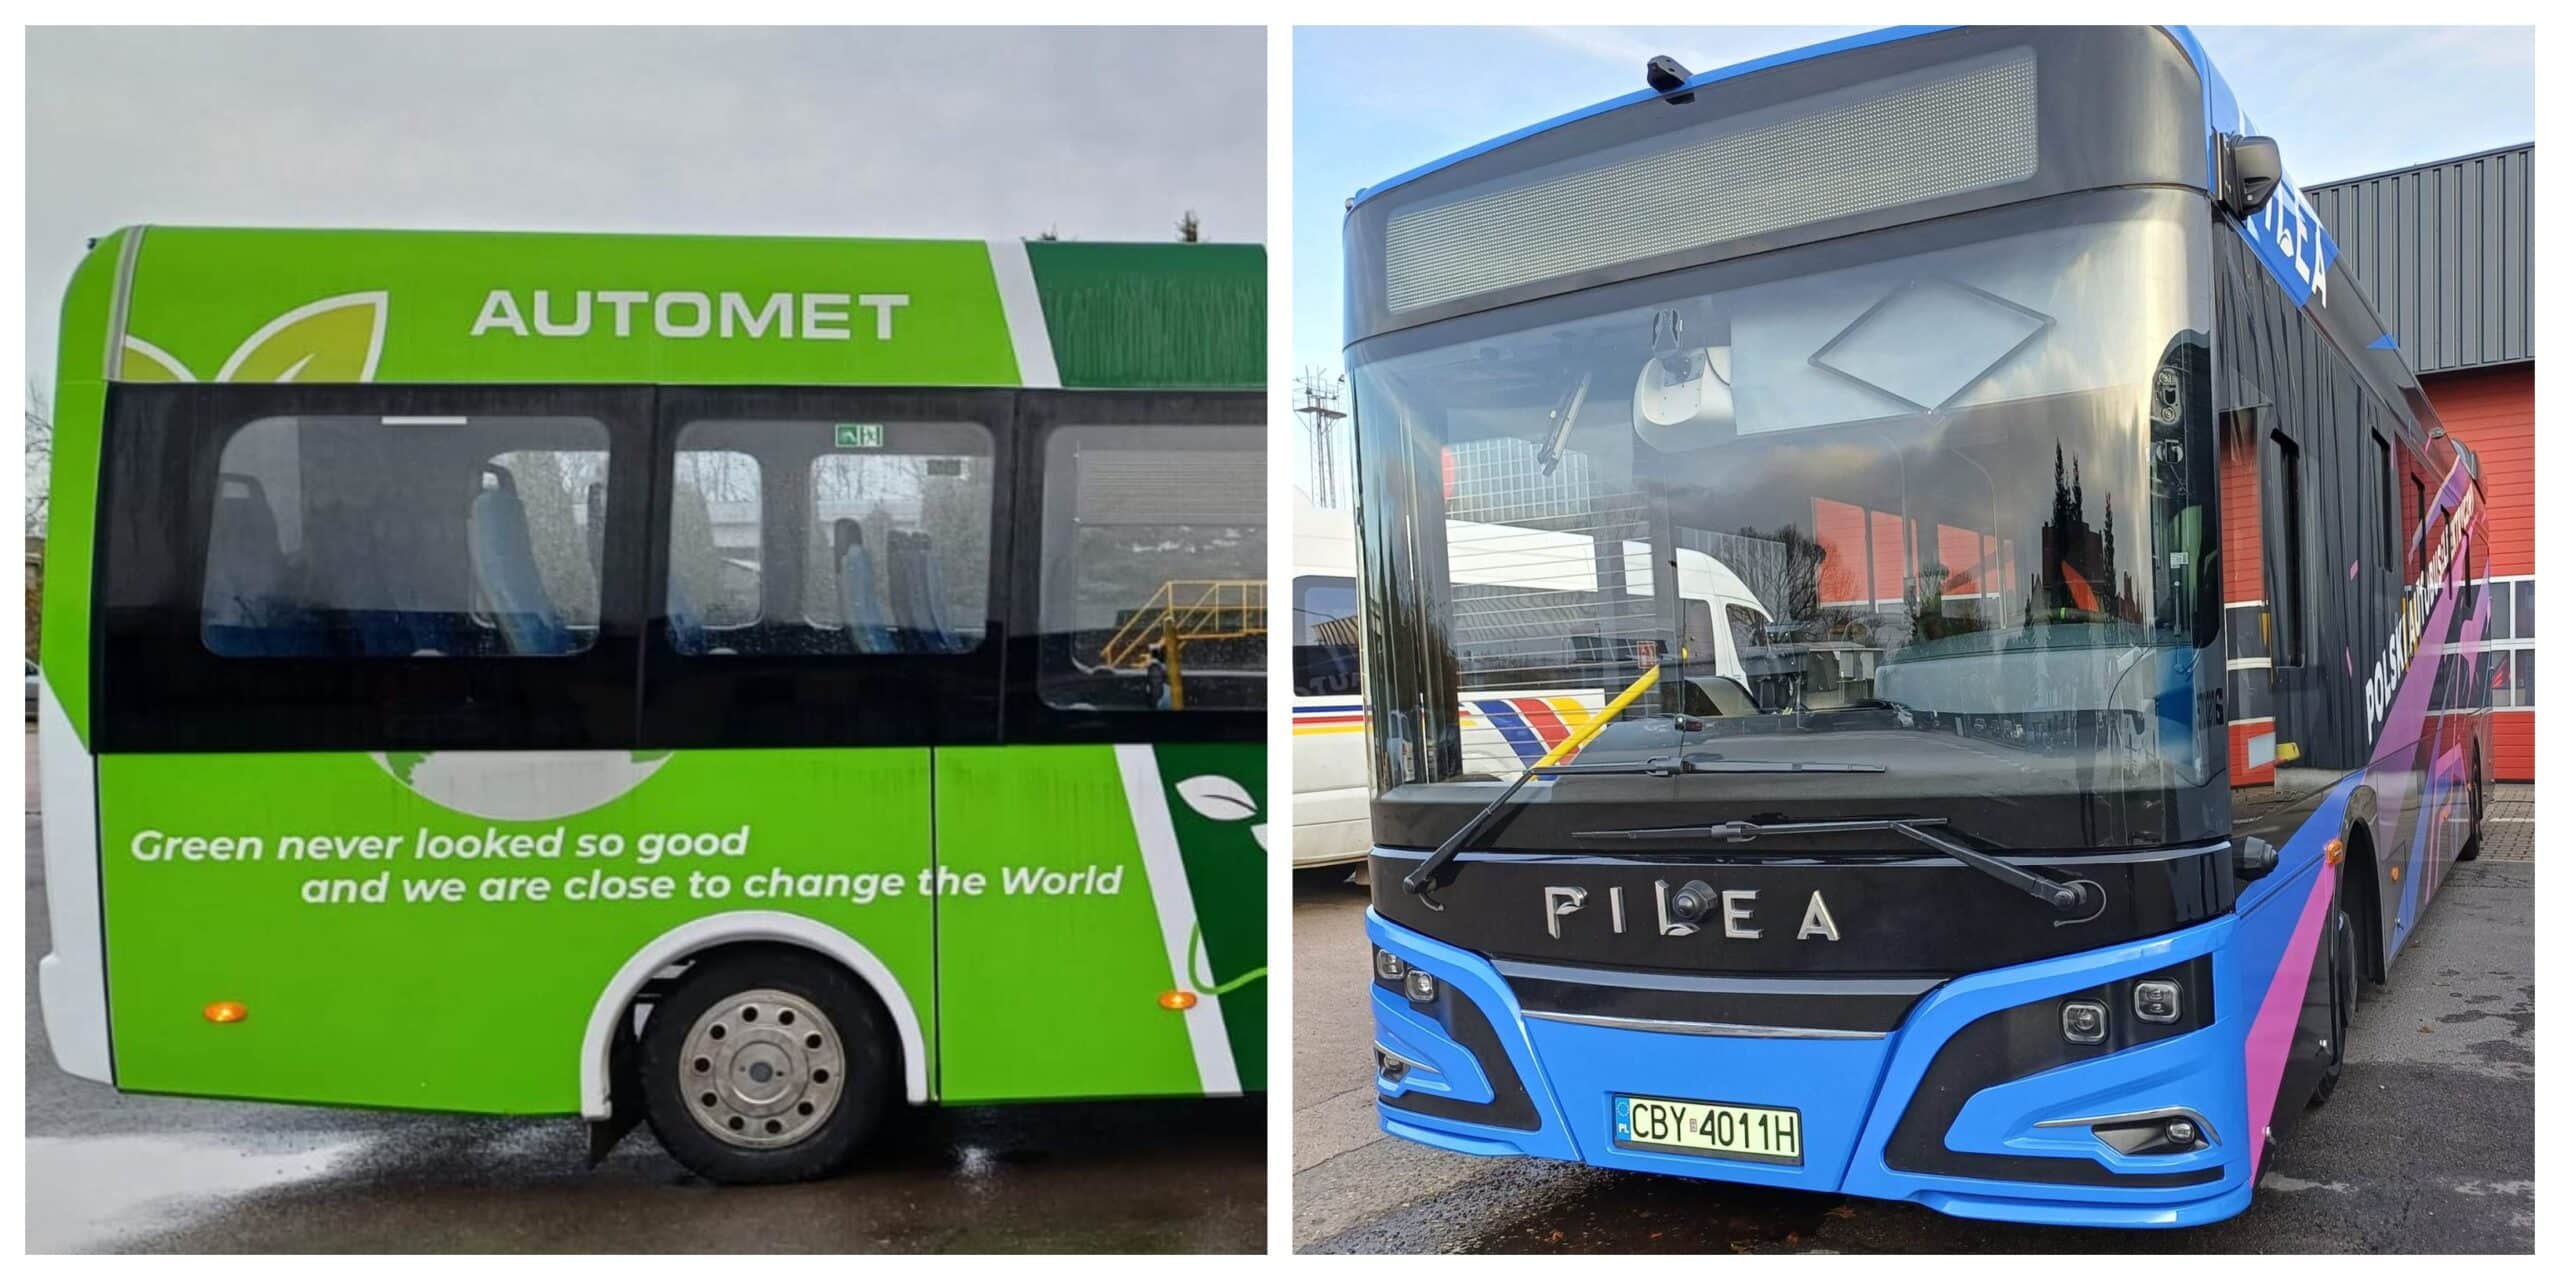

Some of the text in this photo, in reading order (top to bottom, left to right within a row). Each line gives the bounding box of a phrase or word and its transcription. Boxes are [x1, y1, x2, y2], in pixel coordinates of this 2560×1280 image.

[470, 289, 910, 341] AUTOMET
[2365, 612, 2410, 744] POLSKI
[130, 824, 750, 866] Green never looked so good
[301, 863, 1125, 904] and we are close to change the World
[1544, 879, 1841, 942] PILEA
[1632, 1103, 1687, 1142] CBY
[1699, 1109, 1796, 1153] 4011H
